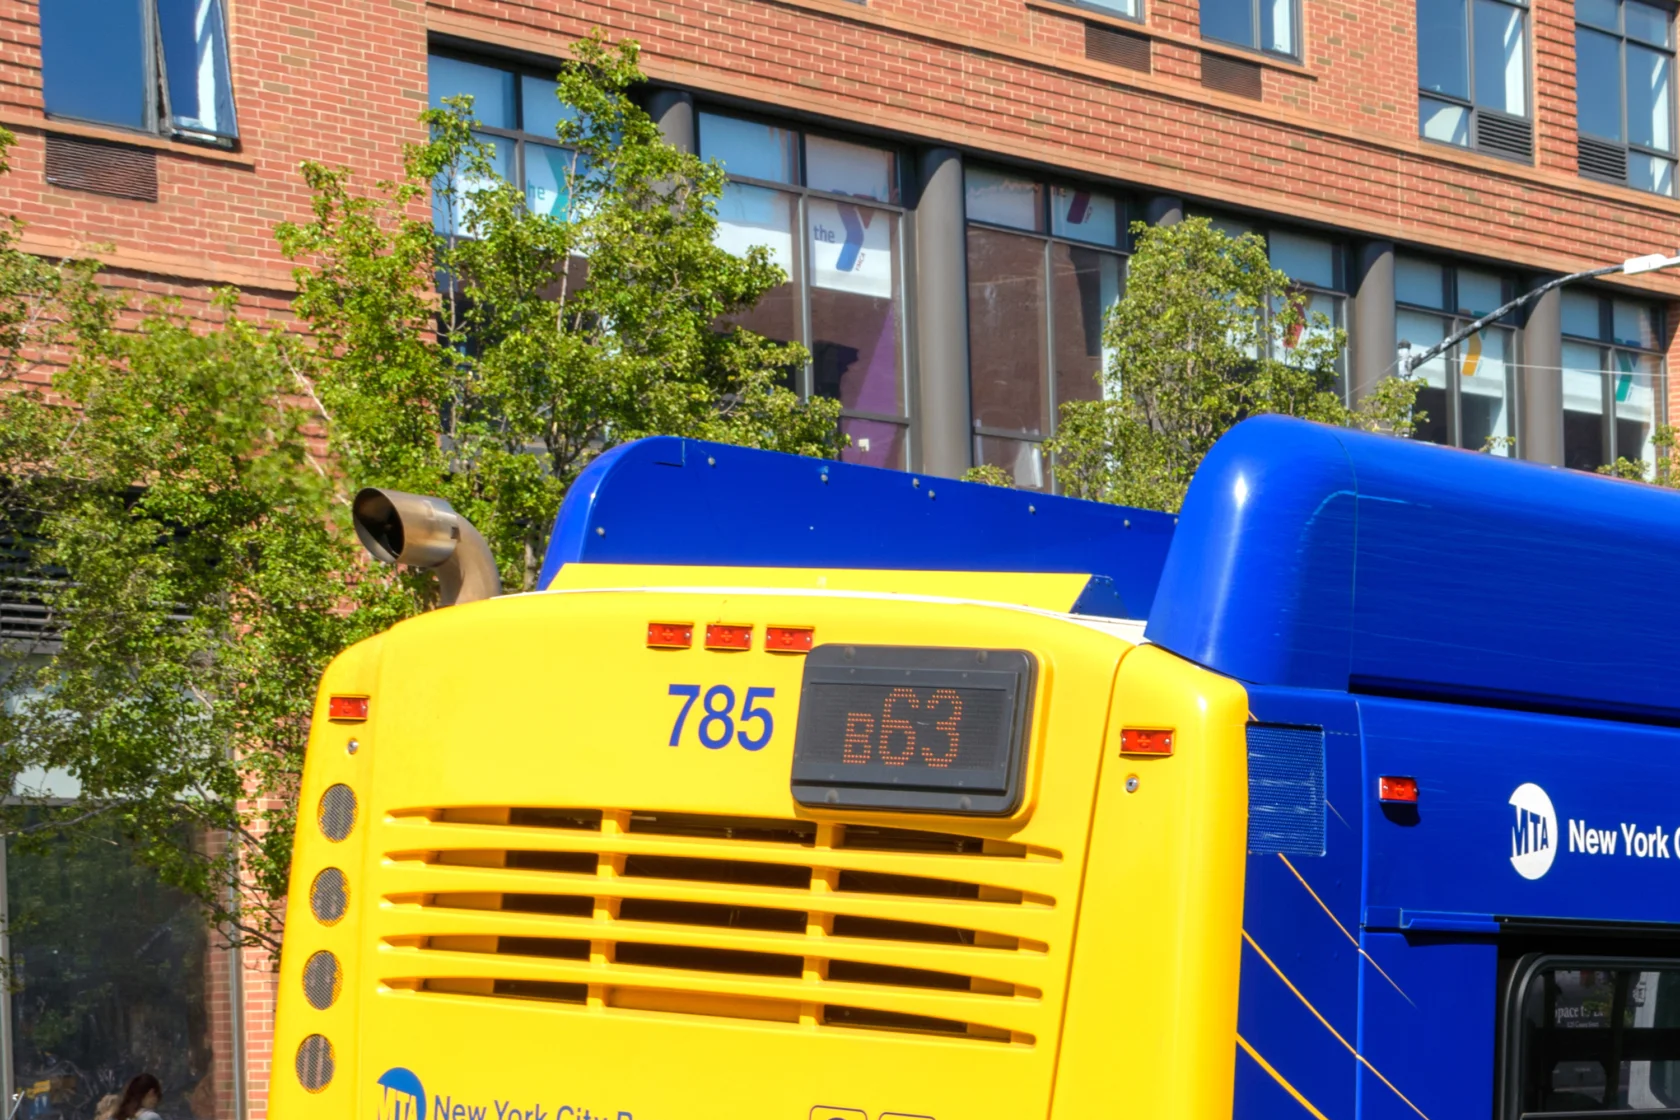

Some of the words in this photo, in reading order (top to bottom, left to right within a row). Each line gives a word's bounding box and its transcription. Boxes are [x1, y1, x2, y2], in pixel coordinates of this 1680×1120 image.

[527, 180, 545, 200] he
[668, 684, 775, 751] 785
[843, 687, 962, 768] B63
[1510, 799, 1553, 862] MTA
[1569, 819, 1617, 855] New
[1621, 822, 1670, 859] York
